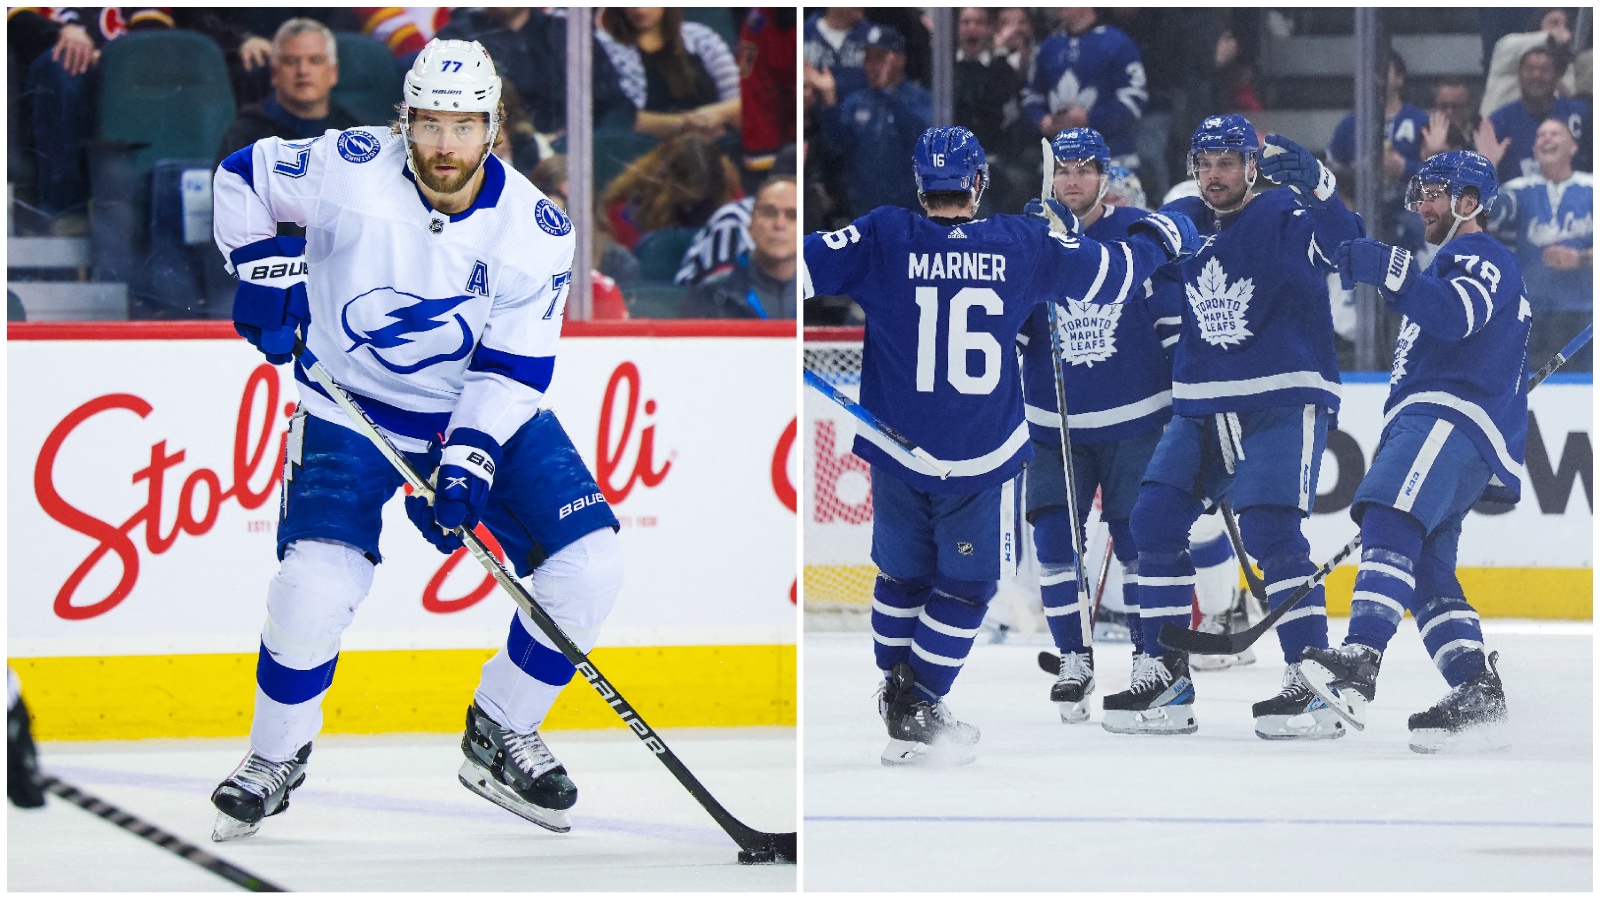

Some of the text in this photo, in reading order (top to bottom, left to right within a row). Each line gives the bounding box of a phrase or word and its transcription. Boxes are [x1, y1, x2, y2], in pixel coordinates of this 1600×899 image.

[440, 60, 463, 73] 77
[1395, 118, 1415, 143] A
[273, 143, 312, 178] 7
[932, 153, 945, 168] 16
[816, 224, 861, 250] 6
[465, 260, 489, 297] A
[908, 252, 1006, 282] MARNER
[1454, 254, 1501, 293] 78
[542, 268, 572, 320] 7
[1196, 298, 1241, 315] TORONTO
[1061, 317, 1111, 333] TORONTO
[1203, 311, 1234, 322] MAPLE
[1206, 321, 1236, 332] LEAFS
[915, 286, 1004, 395] 16
[1070, 329, 1104, 341] MAPLE
[1071, 339, 1105, 351] LEAFS
[1404, 471, 1420, 497] CCM
